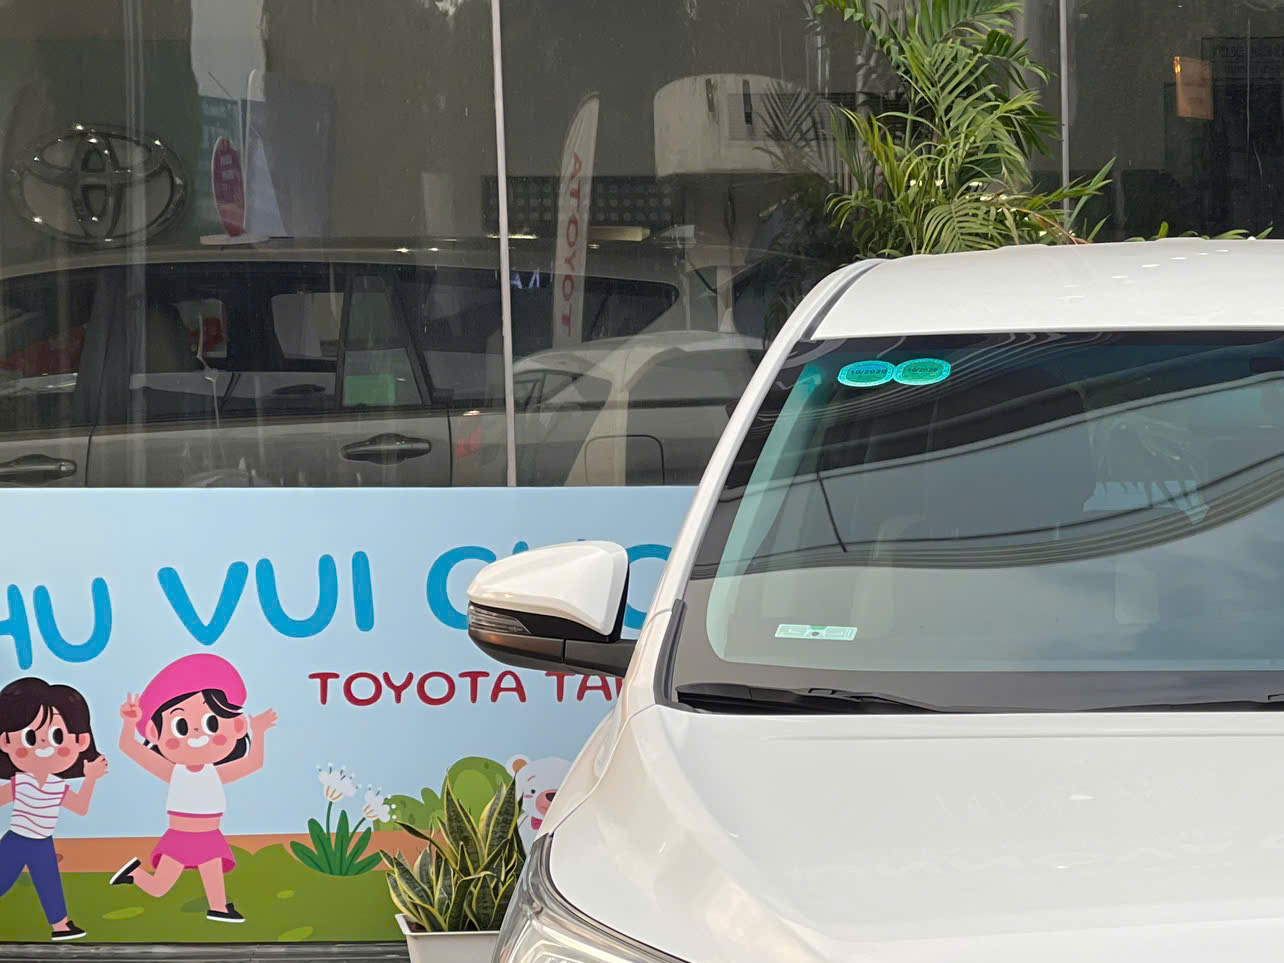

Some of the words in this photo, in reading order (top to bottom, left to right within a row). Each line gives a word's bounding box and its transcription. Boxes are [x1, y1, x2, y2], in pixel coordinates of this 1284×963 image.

[157, 550, 375, 646] VUI
[308, 670, 527, 706] TOYOTA
[545, 671, 623, 703] TA
